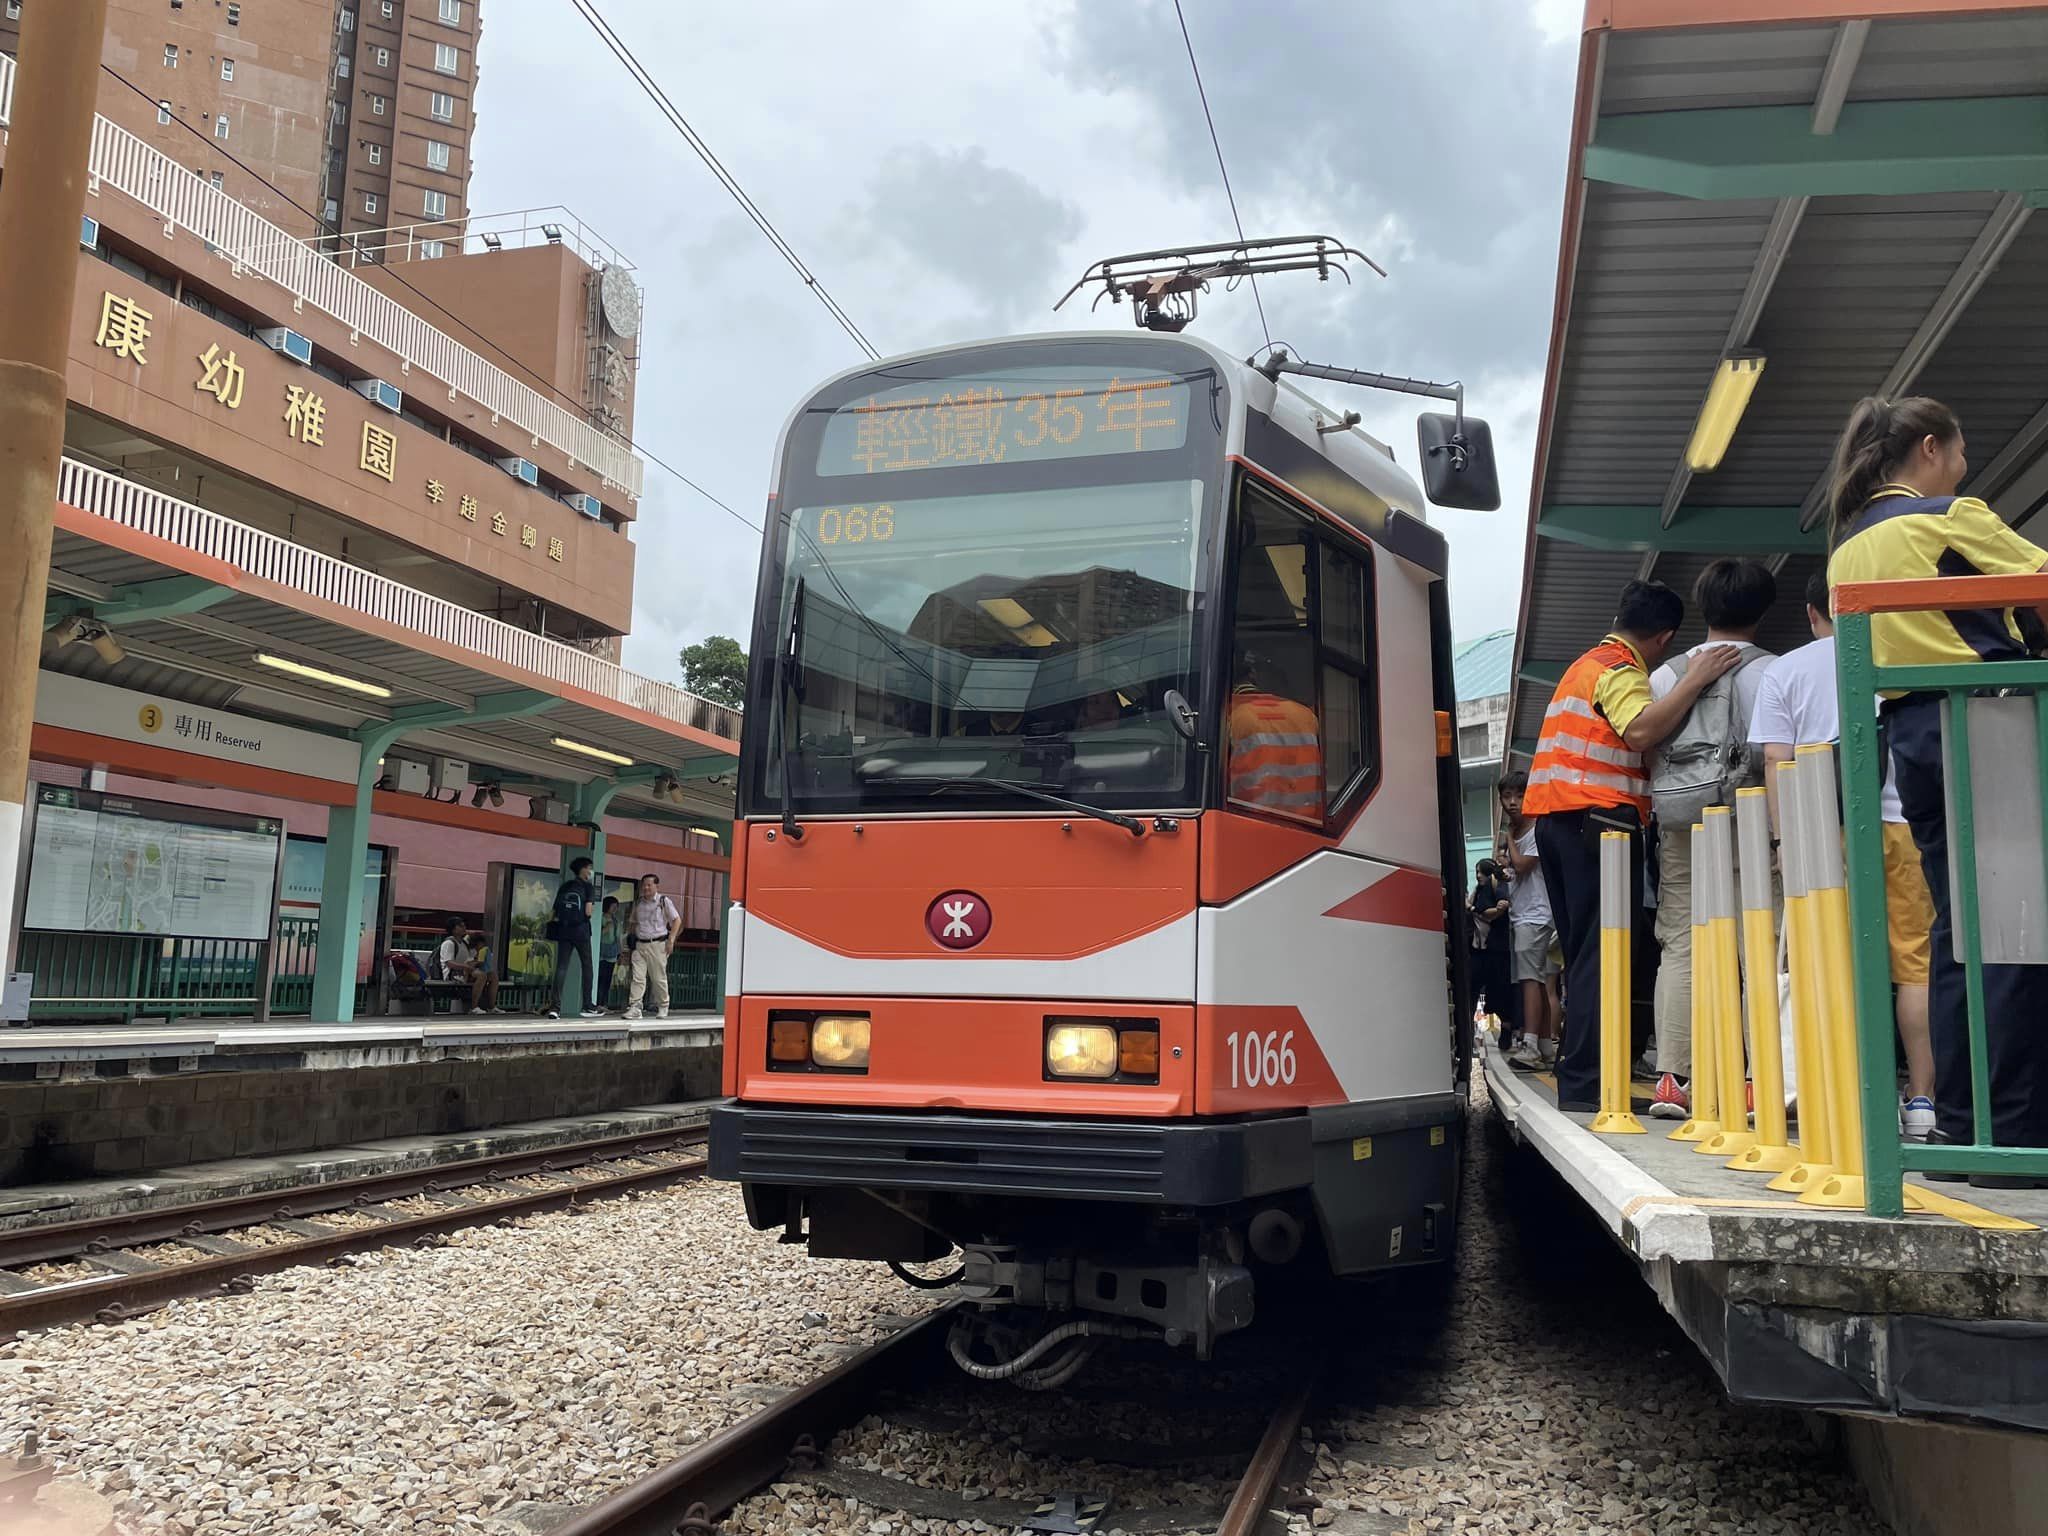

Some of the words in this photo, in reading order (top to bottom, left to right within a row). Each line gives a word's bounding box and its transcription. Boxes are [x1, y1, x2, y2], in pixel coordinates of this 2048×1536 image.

[96, 291, 397, 482] 康幼稚園
[818, 504, 895, 544] 066
[144, 709, 156, 728] 3
[174, 714, 212, 741] 專用
[215, 731, 262, 752] Reserved
[1227, 1030, 1297, 1089] 1066
